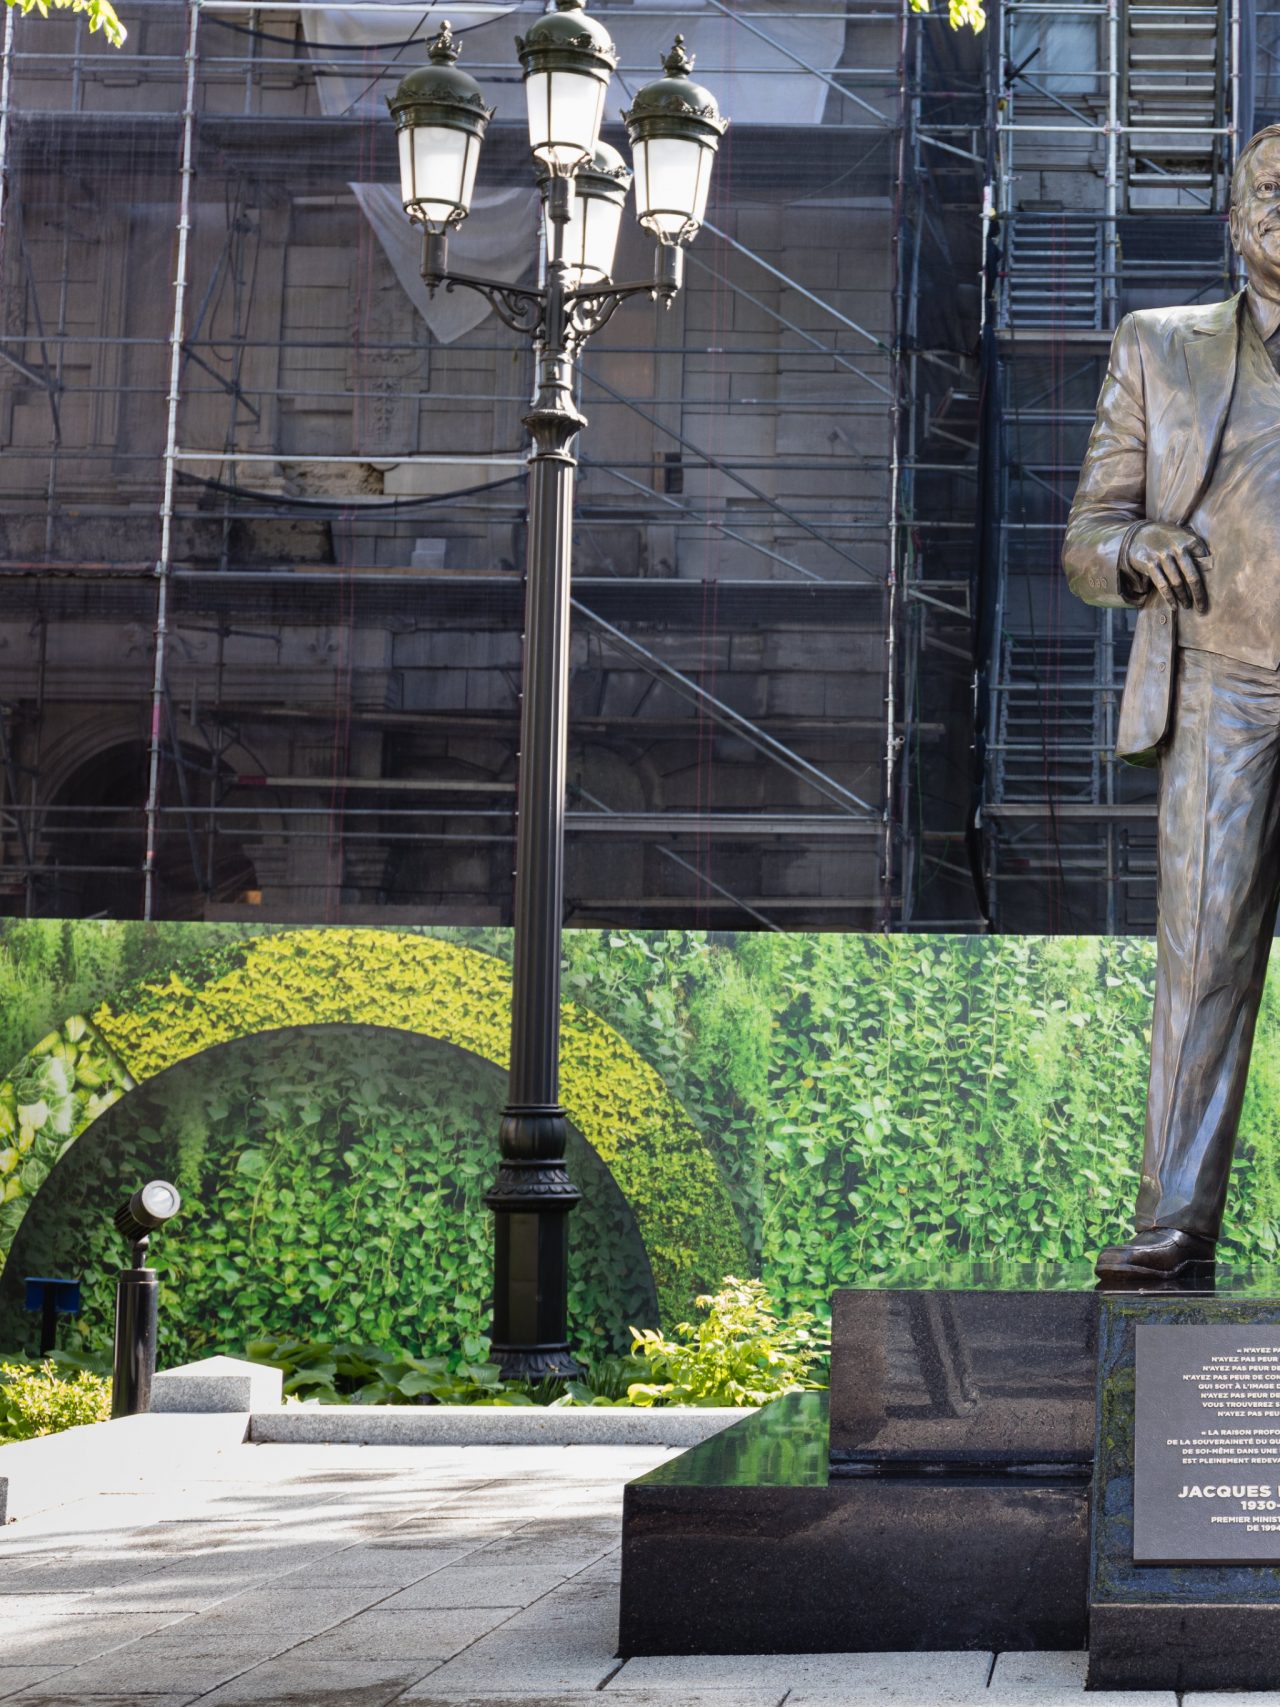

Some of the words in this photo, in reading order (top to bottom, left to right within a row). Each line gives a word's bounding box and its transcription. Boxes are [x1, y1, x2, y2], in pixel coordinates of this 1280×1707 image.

[1234, 1382, 1242, 1390] À
[1195, 1447, 1235, 1455] SOI-MÊME
[1178, 1485, 1272, 1498] JACQUES
[1246, 1524, 1260, 1532] DE
